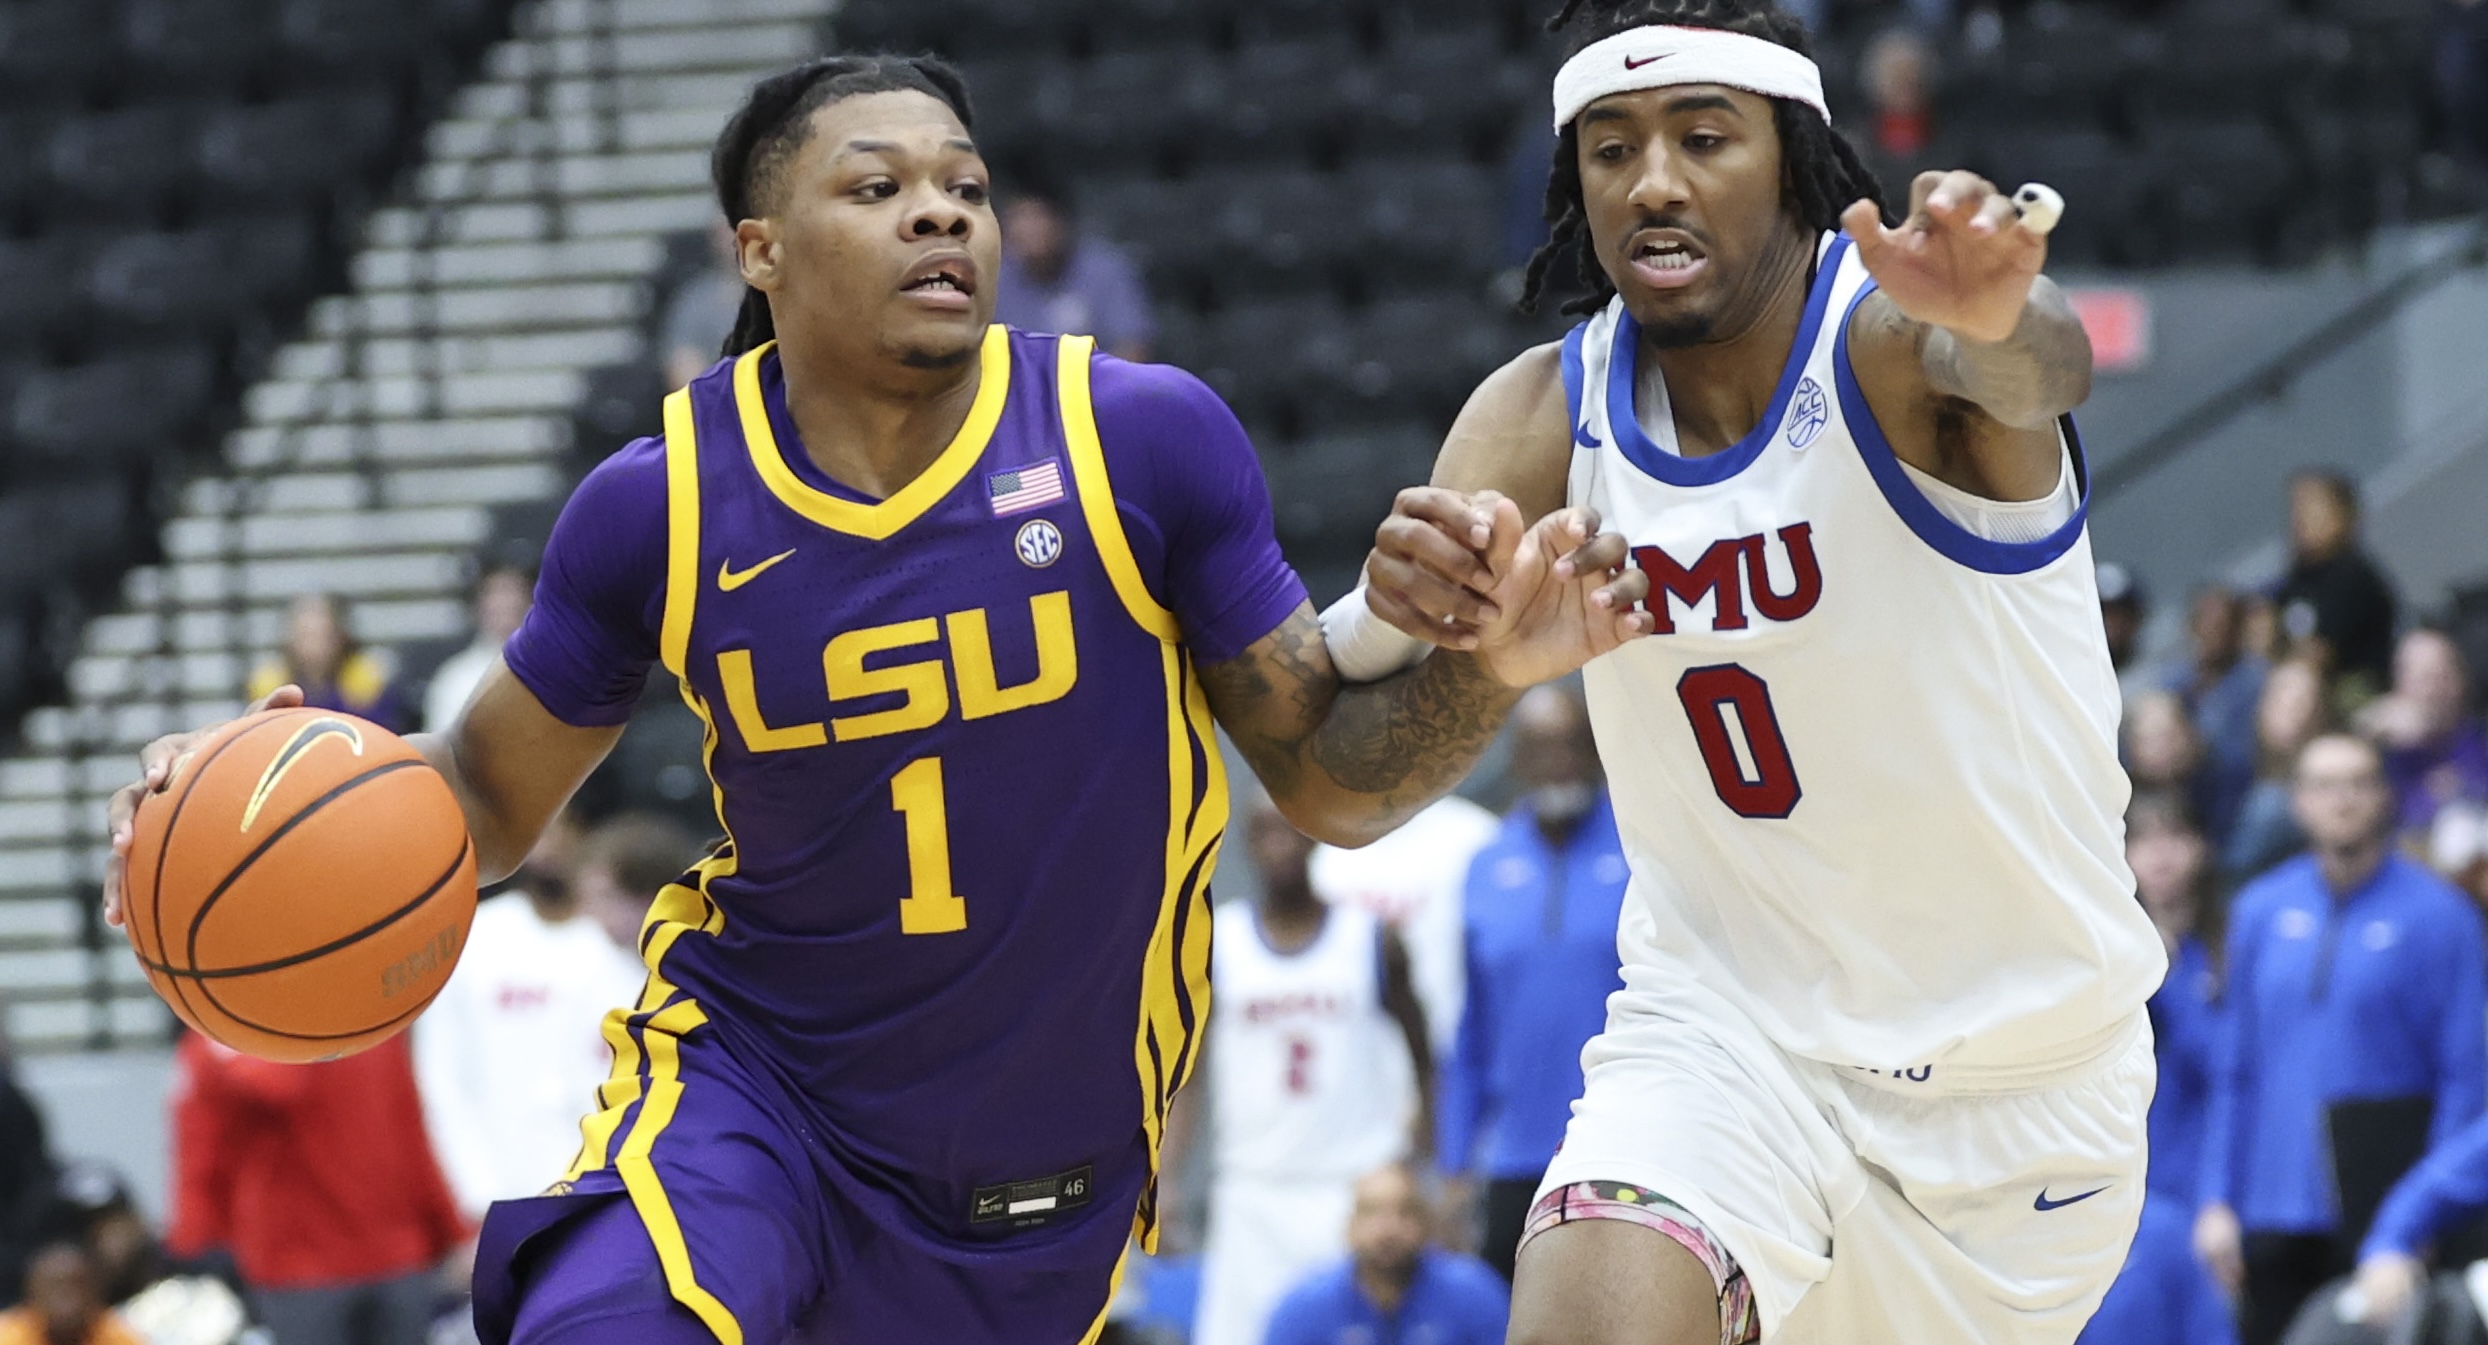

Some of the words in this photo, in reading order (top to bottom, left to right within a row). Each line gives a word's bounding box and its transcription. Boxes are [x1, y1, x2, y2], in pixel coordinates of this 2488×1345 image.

[1790, 389, 1822, 426] ACC
[1020, 524, 1058, 563] SEC
[1613, 521, 1822, 634] MU
[717, 590, 1077, 752] LSU
[1676, 662, 1802, 819] 0
[890, 756, 967, 934] 1
[1064, 1178, 1085, 1197] 46
